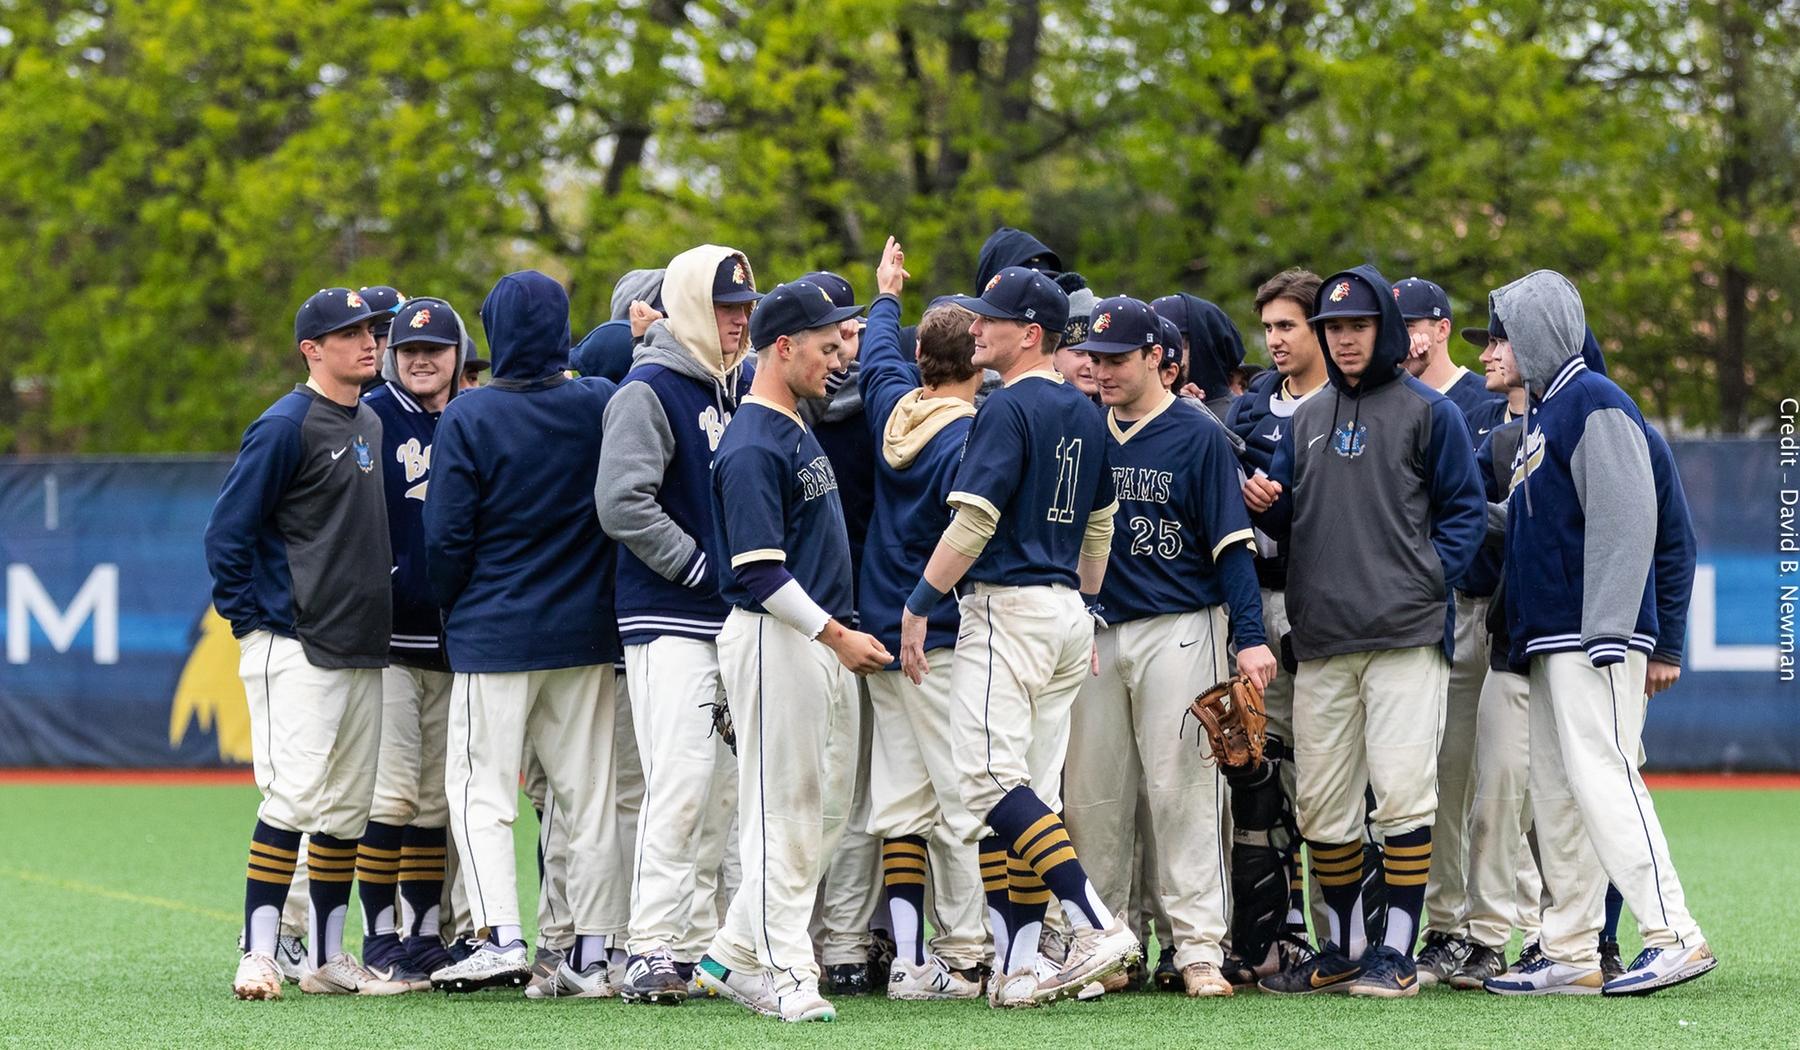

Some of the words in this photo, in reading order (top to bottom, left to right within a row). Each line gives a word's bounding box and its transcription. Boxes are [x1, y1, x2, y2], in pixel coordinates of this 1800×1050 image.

[1047, 436, 1082, 523] 11
[1130, 516, 1183, 560] 25
[6, 562, 119, 665] M
